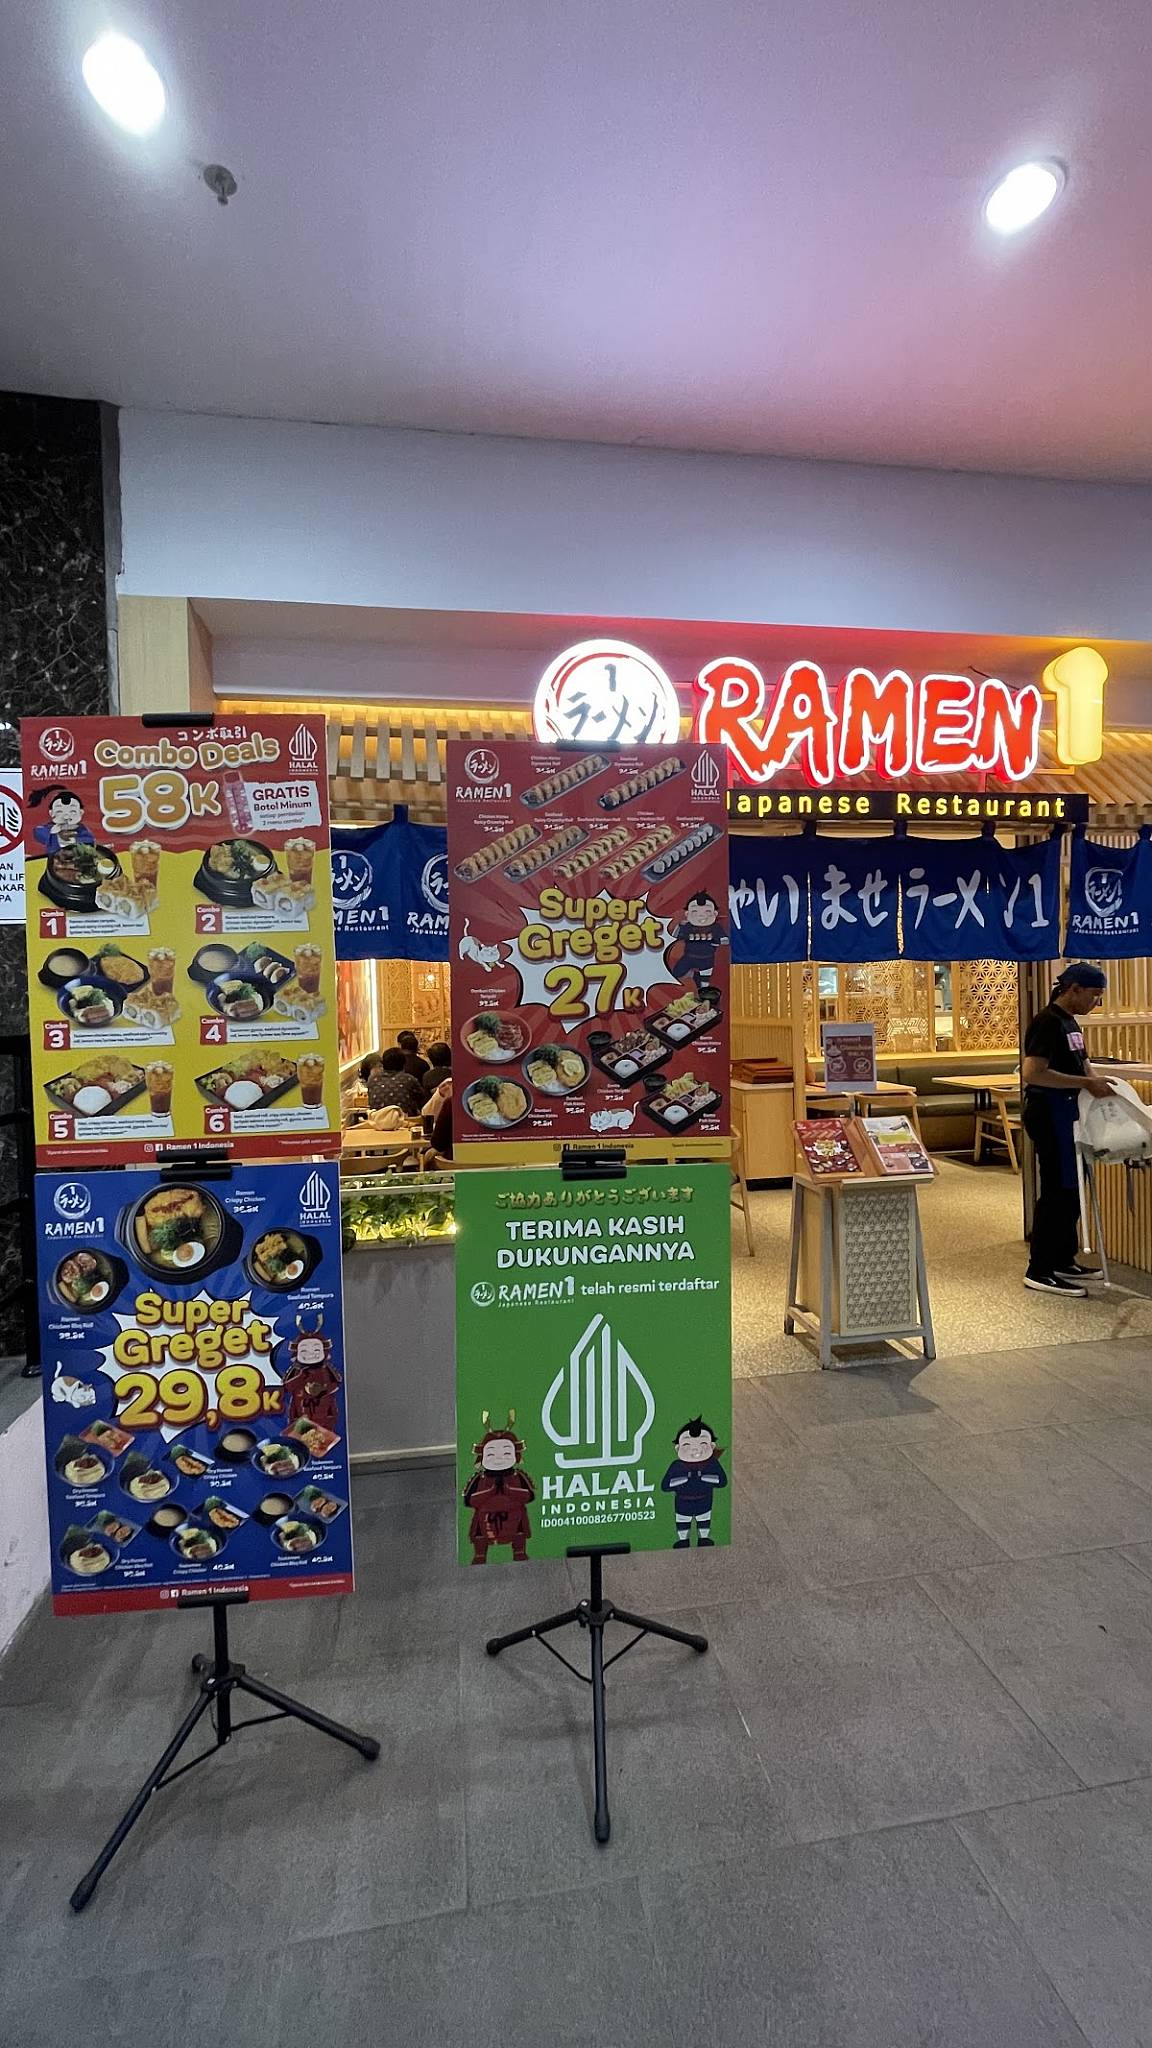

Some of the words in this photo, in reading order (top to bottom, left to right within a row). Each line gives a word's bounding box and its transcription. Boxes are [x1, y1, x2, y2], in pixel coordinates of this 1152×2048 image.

[94, 737, 198, 769] Combo
[198, 732, 280, 771] Deals
[289, 761, 318, 769] HALAL
[252, 786, 310, 801] GRATIS
[253, 803, 279, 812] Botol
[281, 801, 312, 810] Minum
[896, 792, 1065, 818] Restaurant
[540, 887, 645, 928] Super
[46, 917, 57, 935] 1
[201, 913, 216, 932] 2
[518, 917, 664, 963] Greget
[49, 1029, 64, 1048] 3
[205, 1024, 221, 1042] 4
[54, 1120, 68, 1139] 5
[209, 1114, 225, 1132] 6
[198, 1141, 234, 1149] Indonesia
[300, 1211, 331, 1220] HALAL
[505, 1218, 602, 1241] TERIMA
[608, 1215, 685, 1237] KASIH
[497, 1241, 695, 1269] DUKUNGANNYA
[581, 1282, 615, 1297] telah
[618, 1279, 656, 1294] resmi
[658, 1277, 720, 1292] terdaftar
[135, 1292, 249, 1333] Super
[113, 1320, 271, 1369] Greget
[542, 1469, 655, 1500] HALAL
[541, 1497, 655, 1516] INDONESIA
[181, 1588, 206, 1596] Ramen
[213, 1585, 249, 1594] Indonesia
